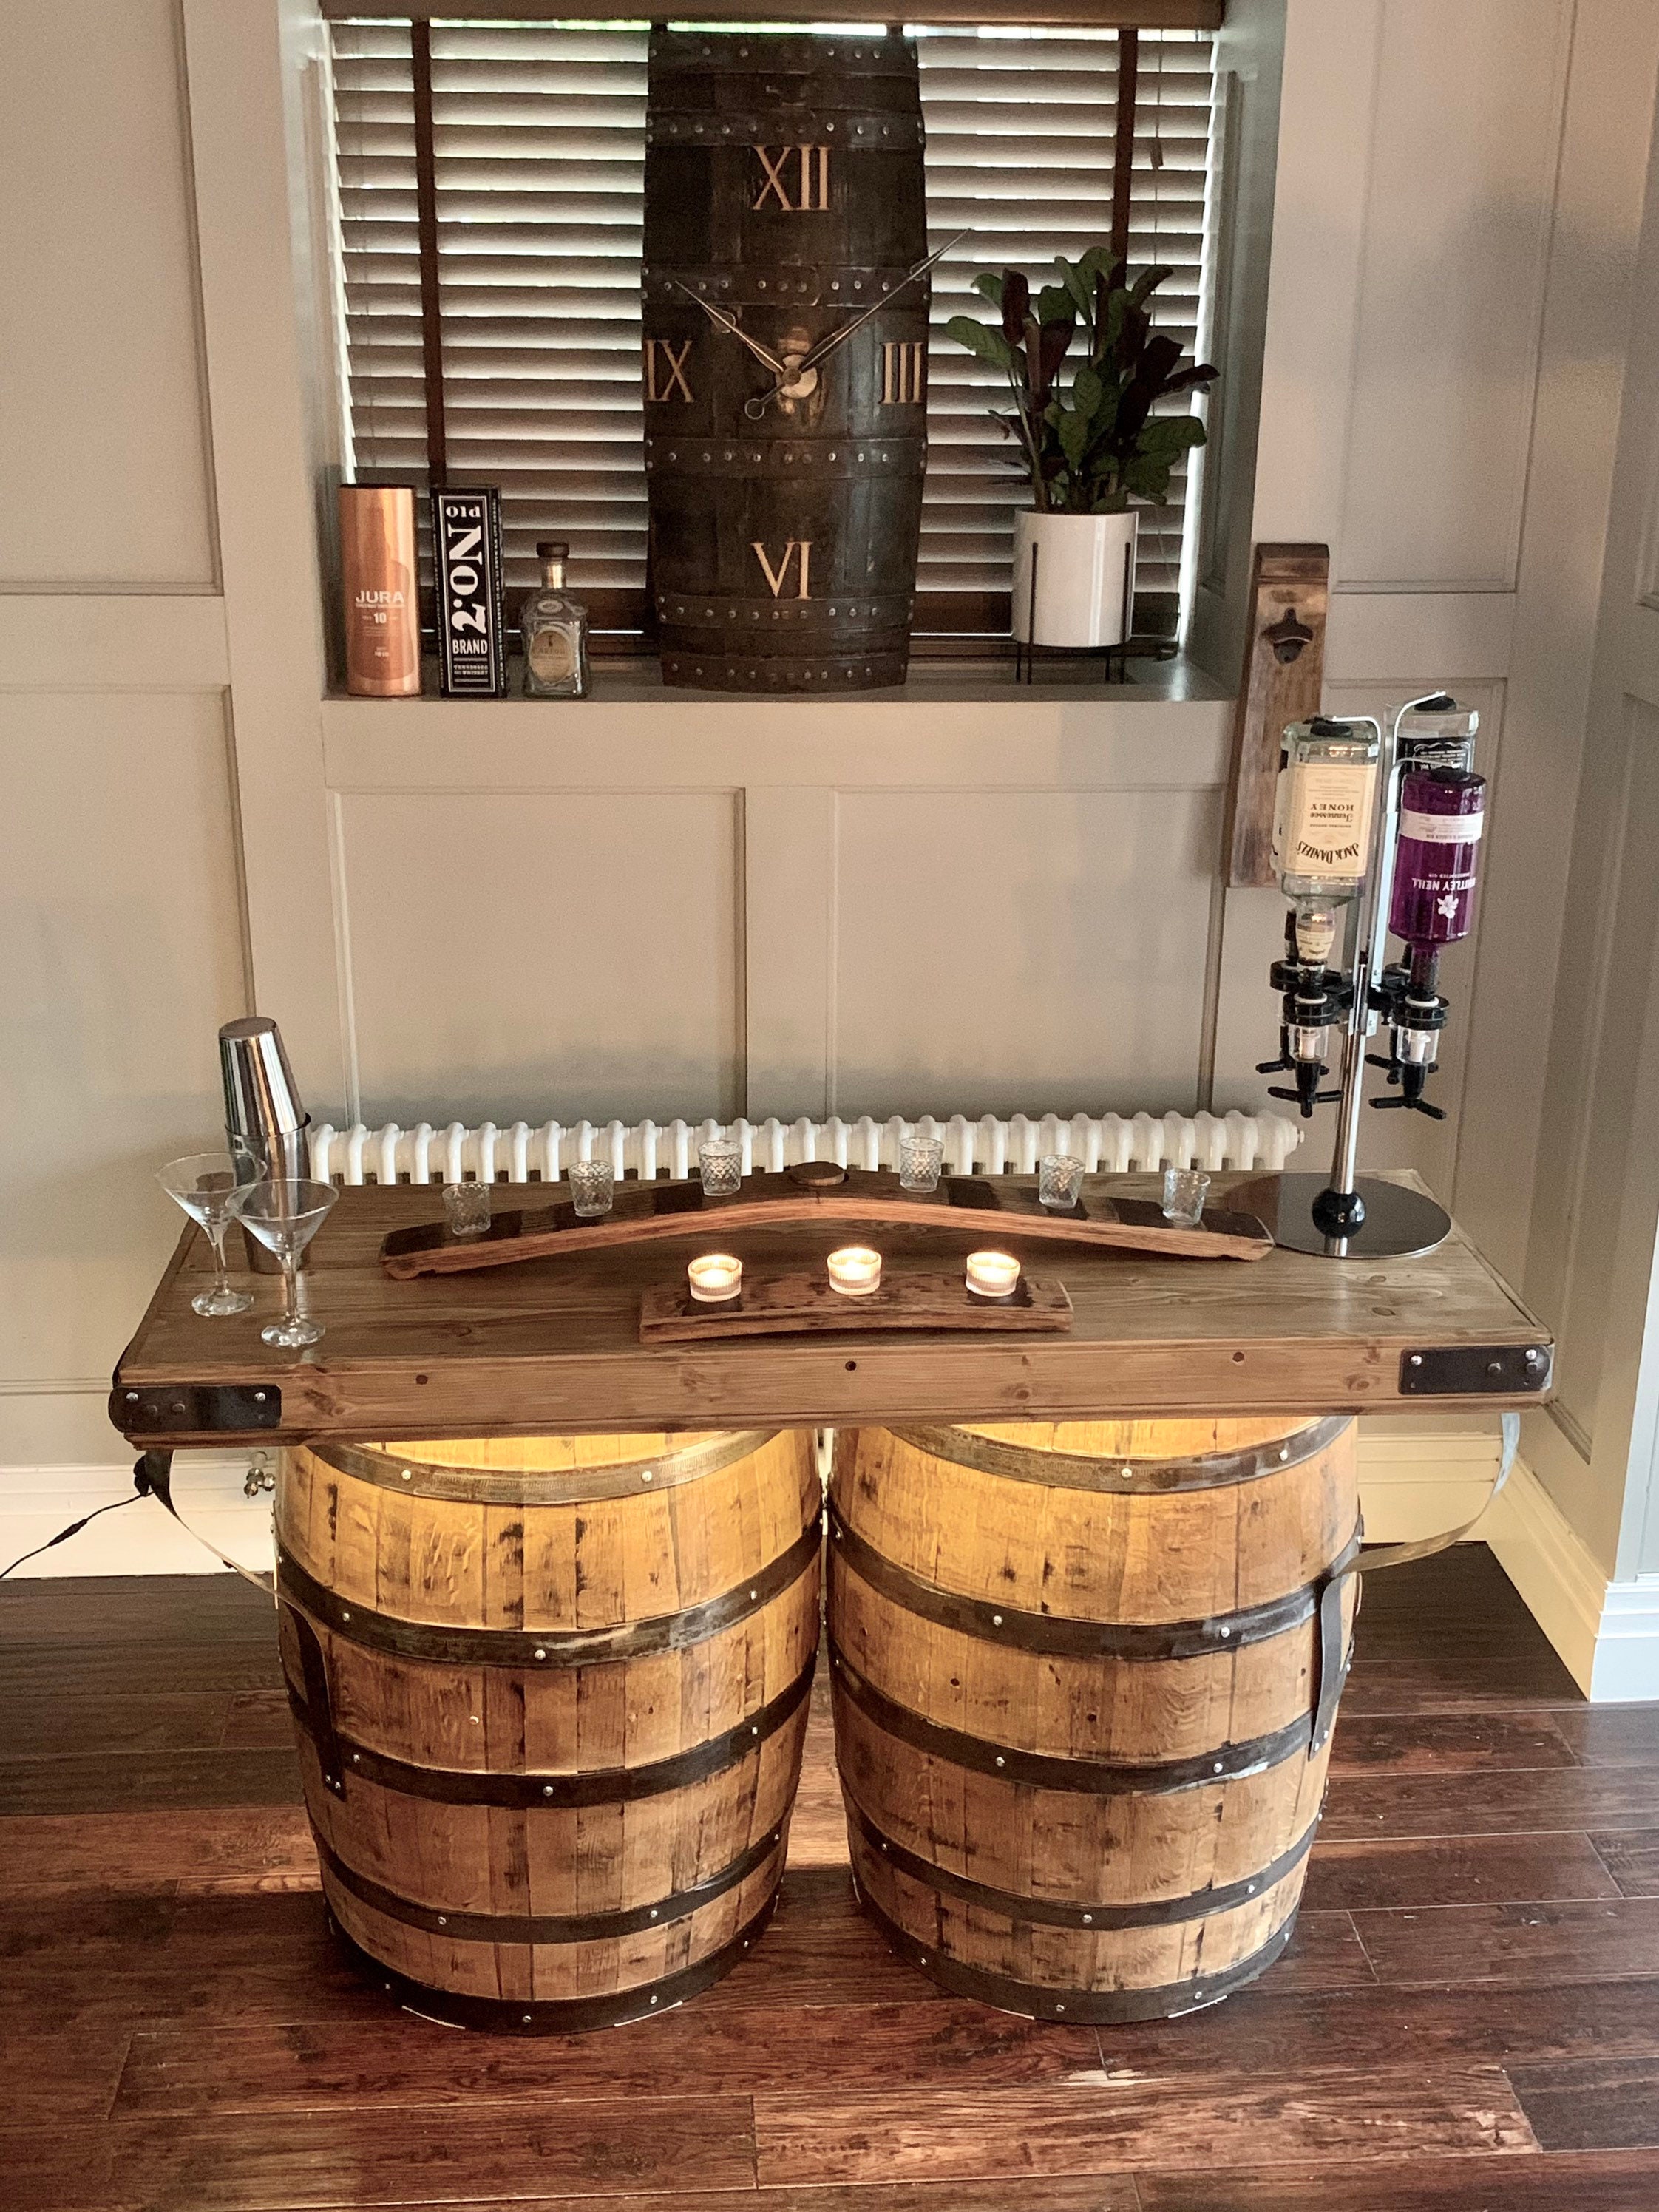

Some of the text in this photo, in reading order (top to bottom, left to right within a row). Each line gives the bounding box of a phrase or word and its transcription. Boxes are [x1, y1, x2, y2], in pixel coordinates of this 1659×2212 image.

[753, 145, 832, 211] XII
[645, 339, 695, 403] IX
[881, 342, 924, 404] III
[446, 506, 481, 518] Old
[750, 540, 815, 600] VI
[355, 591, 404, 604] JURA
[373, 612, 387, 624] 10
[452, 639, 488, 654] BRAND
[1335, 842, 1359, 860] JACK
[1411, 878, 1440, 891] NEILL
